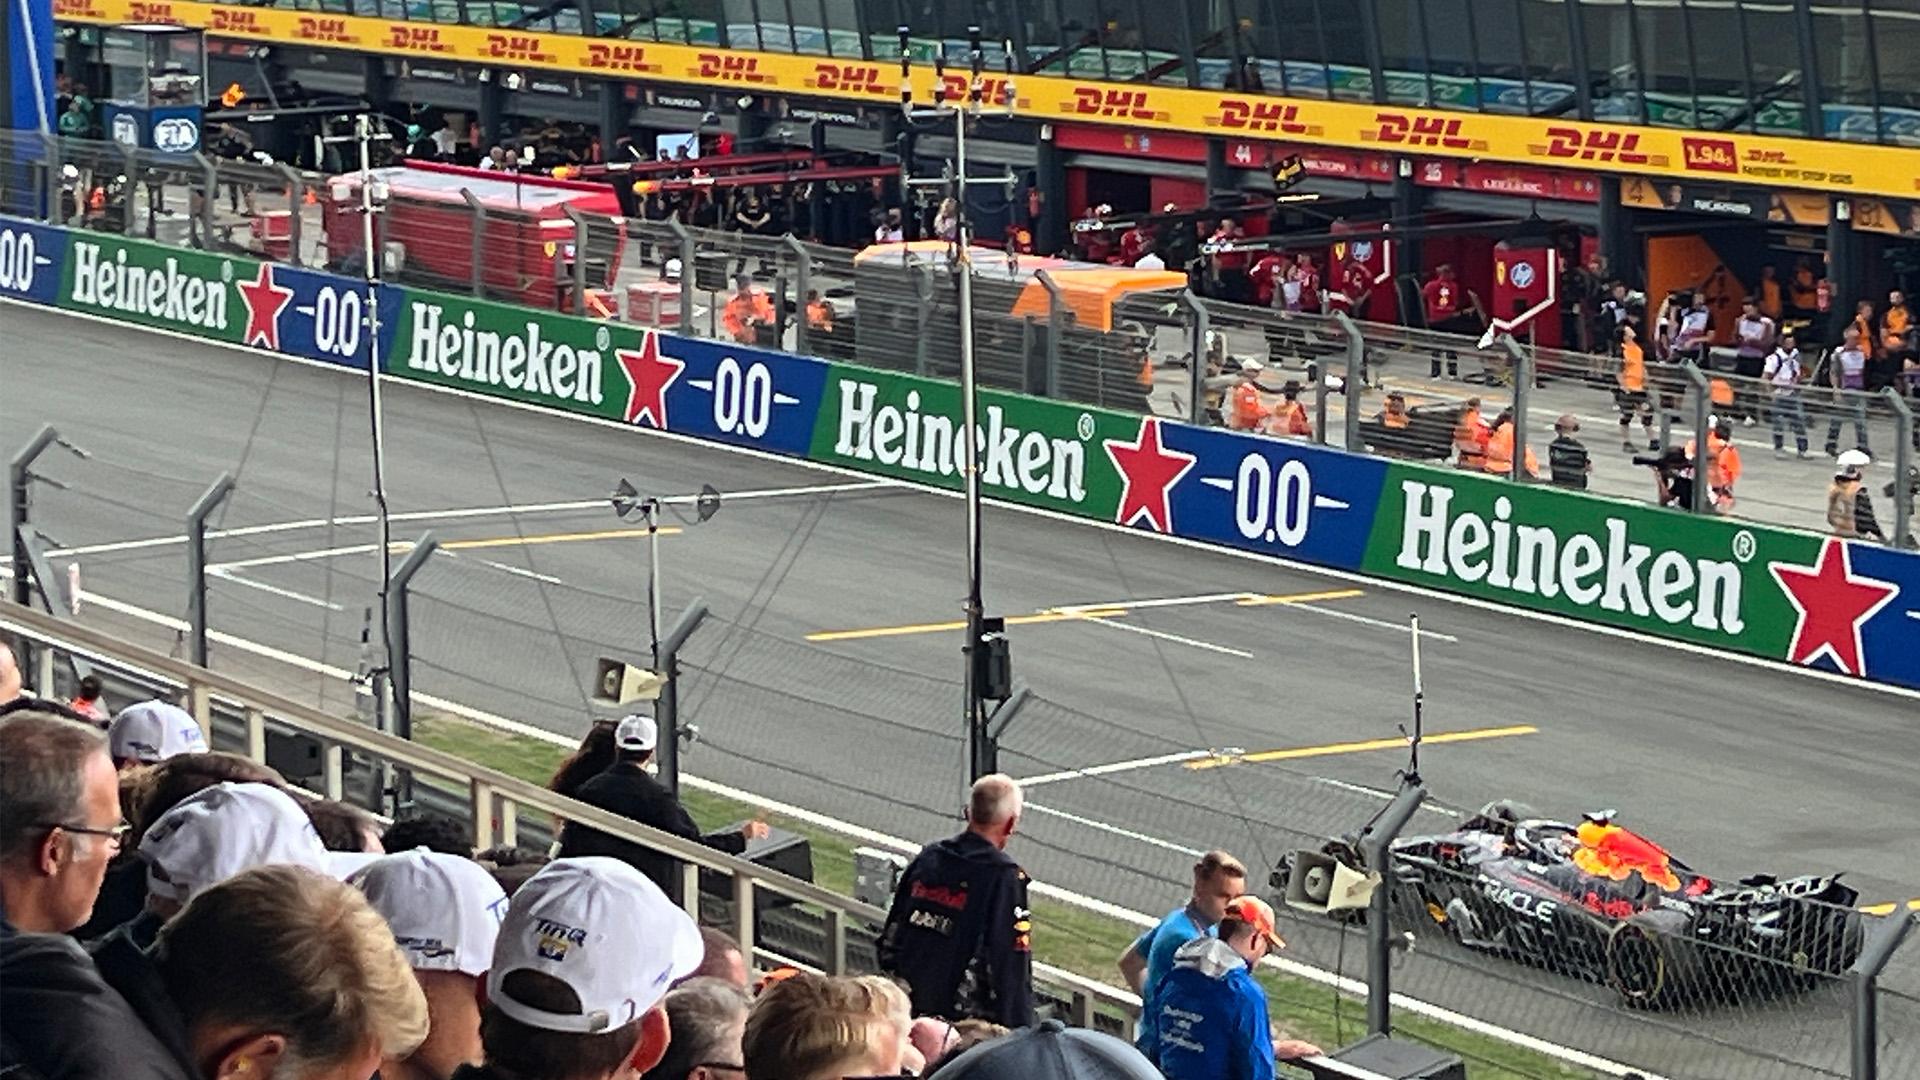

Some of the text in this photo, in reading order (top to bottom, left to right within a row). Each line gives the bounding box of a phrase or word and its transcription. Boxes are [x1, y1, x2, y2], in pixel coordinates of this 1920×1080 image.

[129, 1, 177, 24] DHL
[211, 8, 264, 33] DHL
[297, 17, 354, 41] DHL
[390, 26, 444, 50] DHL
[487, 34, 545, 61] DHL
[588, 44, 649, 71] DHL
[698, 53, 764, 82] DHL
[815, 63, 884, 94] DHL
[1074, 87, 1155, 119] DHL
[1219, 100, 1306, 134] DHL
[154, 121, 198, 150] FIA
[1375, 113, 1472, 149] DHL
[1546, 127, 1648, 164] DHL
[0, 229, 34, 292] 0.0
[72, 241, 228, 329] Heineken
[314, 285, 362, 357] 0.0
[408, 302, 604, 405] Heineken
[713, 356, 773, 439] 0.0
[834, 378, 1087, 503] Heineken
[1235, 452, 1311, 548] 0.0
[1395, 480, 1745, 635] Heineken
